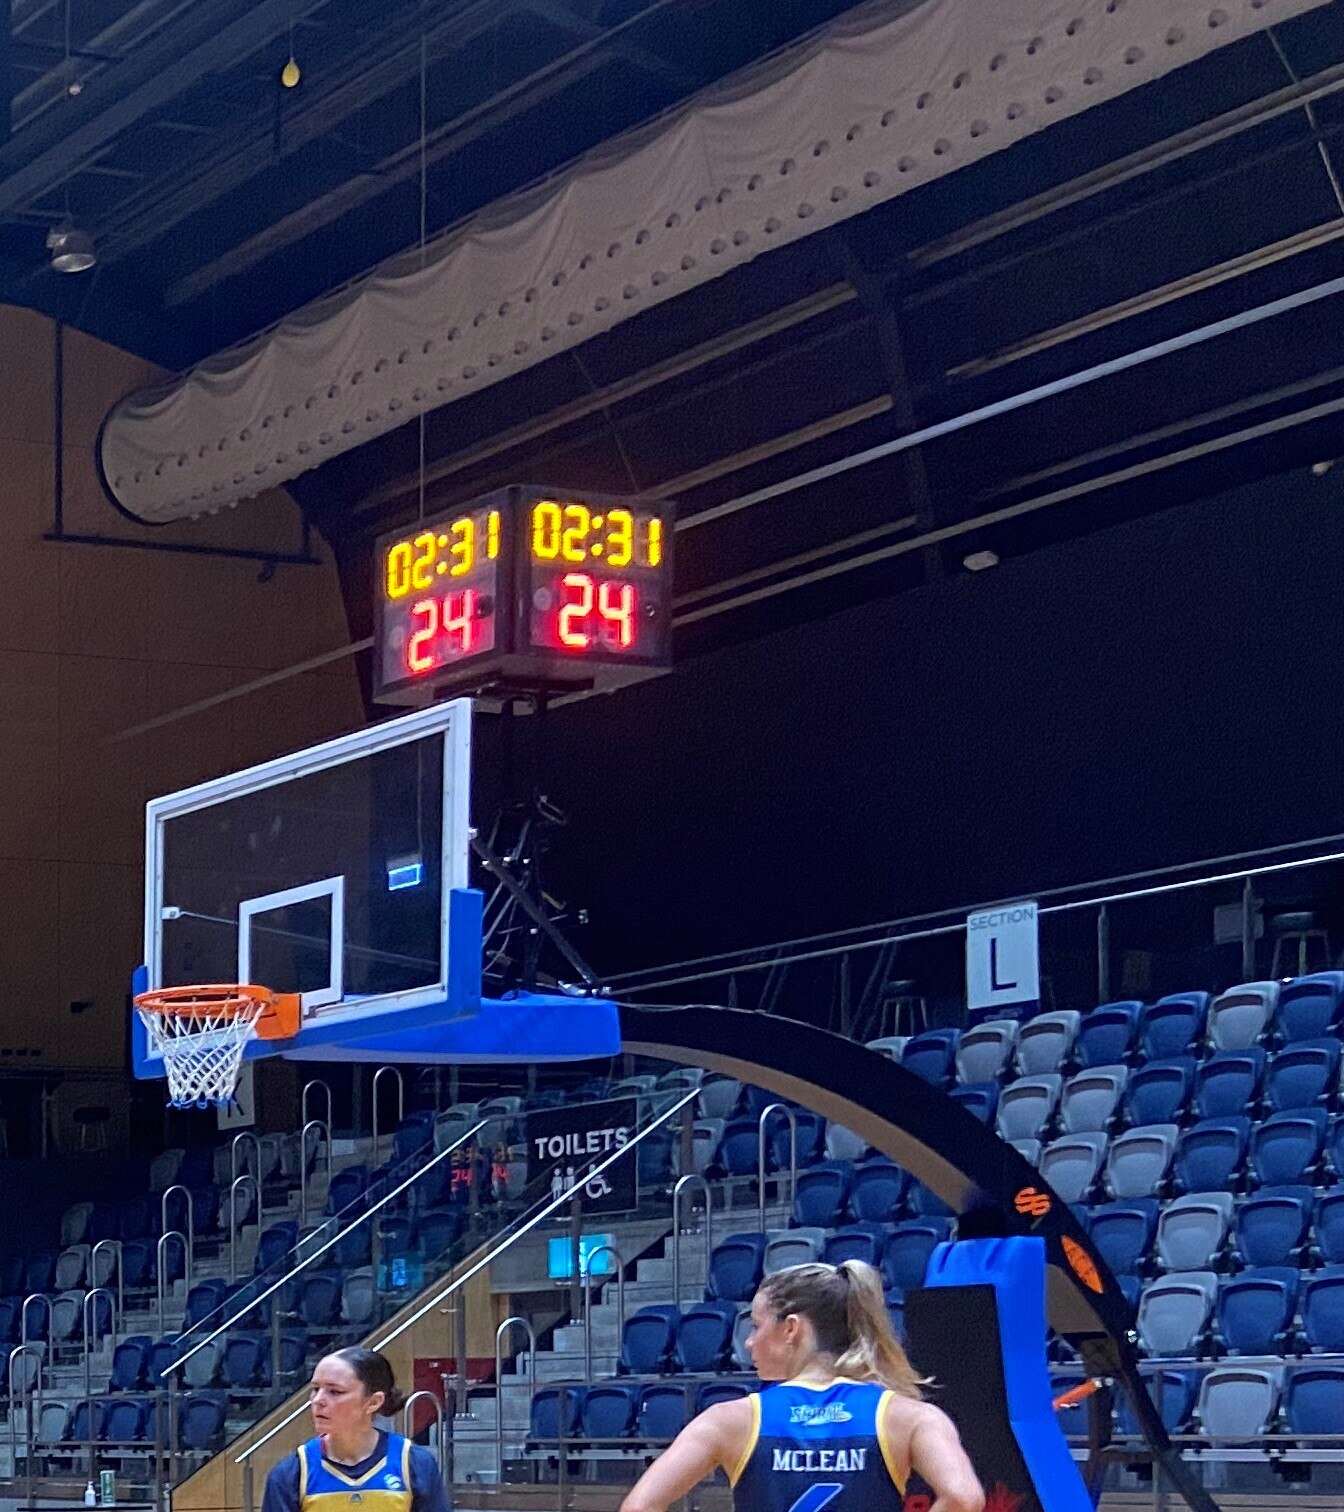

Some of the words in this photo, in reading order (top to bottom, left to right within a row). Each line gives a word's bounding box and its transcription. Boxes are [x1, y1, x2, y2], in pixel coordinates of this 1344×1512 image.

[386, 510, 501, 599] 02:31
[531, 500, 663, 567] 02:31
[407, 588, 474, 672] 24
[558, 573, 635, 649] 24
[970, 906, 1035, 931] SECTION
[990, 937, 1018, 992] L
[534, 1126, 629, 1160] TOILETS
[772, 1447, 868, 1473] MCLEAN
